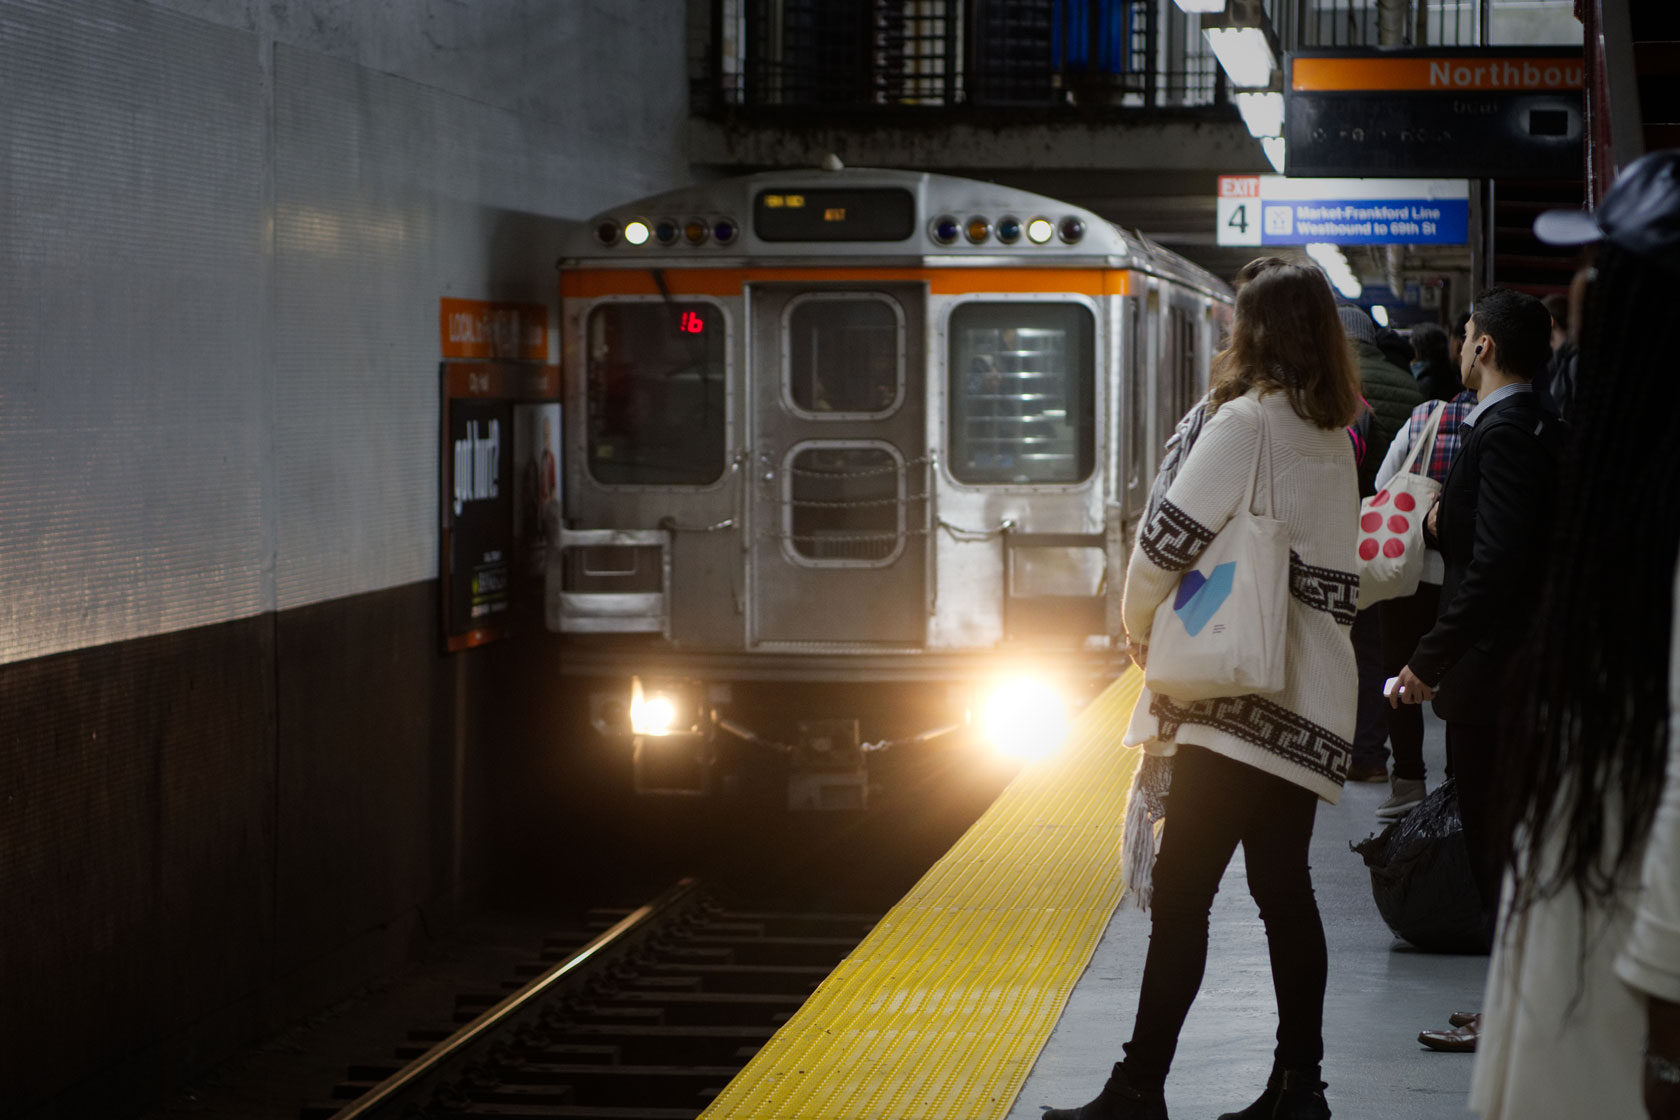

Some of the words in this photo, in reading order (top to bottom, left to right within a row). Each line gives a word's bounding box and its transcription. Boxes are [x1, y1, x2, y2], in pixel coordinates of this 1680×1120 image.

[1222, 179, 1259, 196] EXIT
[1228, 204, 1249, 234] 4
[1297, 206, 1409, 220] Market-Frankford
[1411, 207, 1440, 219] Line
[1297, 222, 1371, 235] Westbound
[1373, 223, 1388, 235] to
[1422, 222, 1436, 235] St
